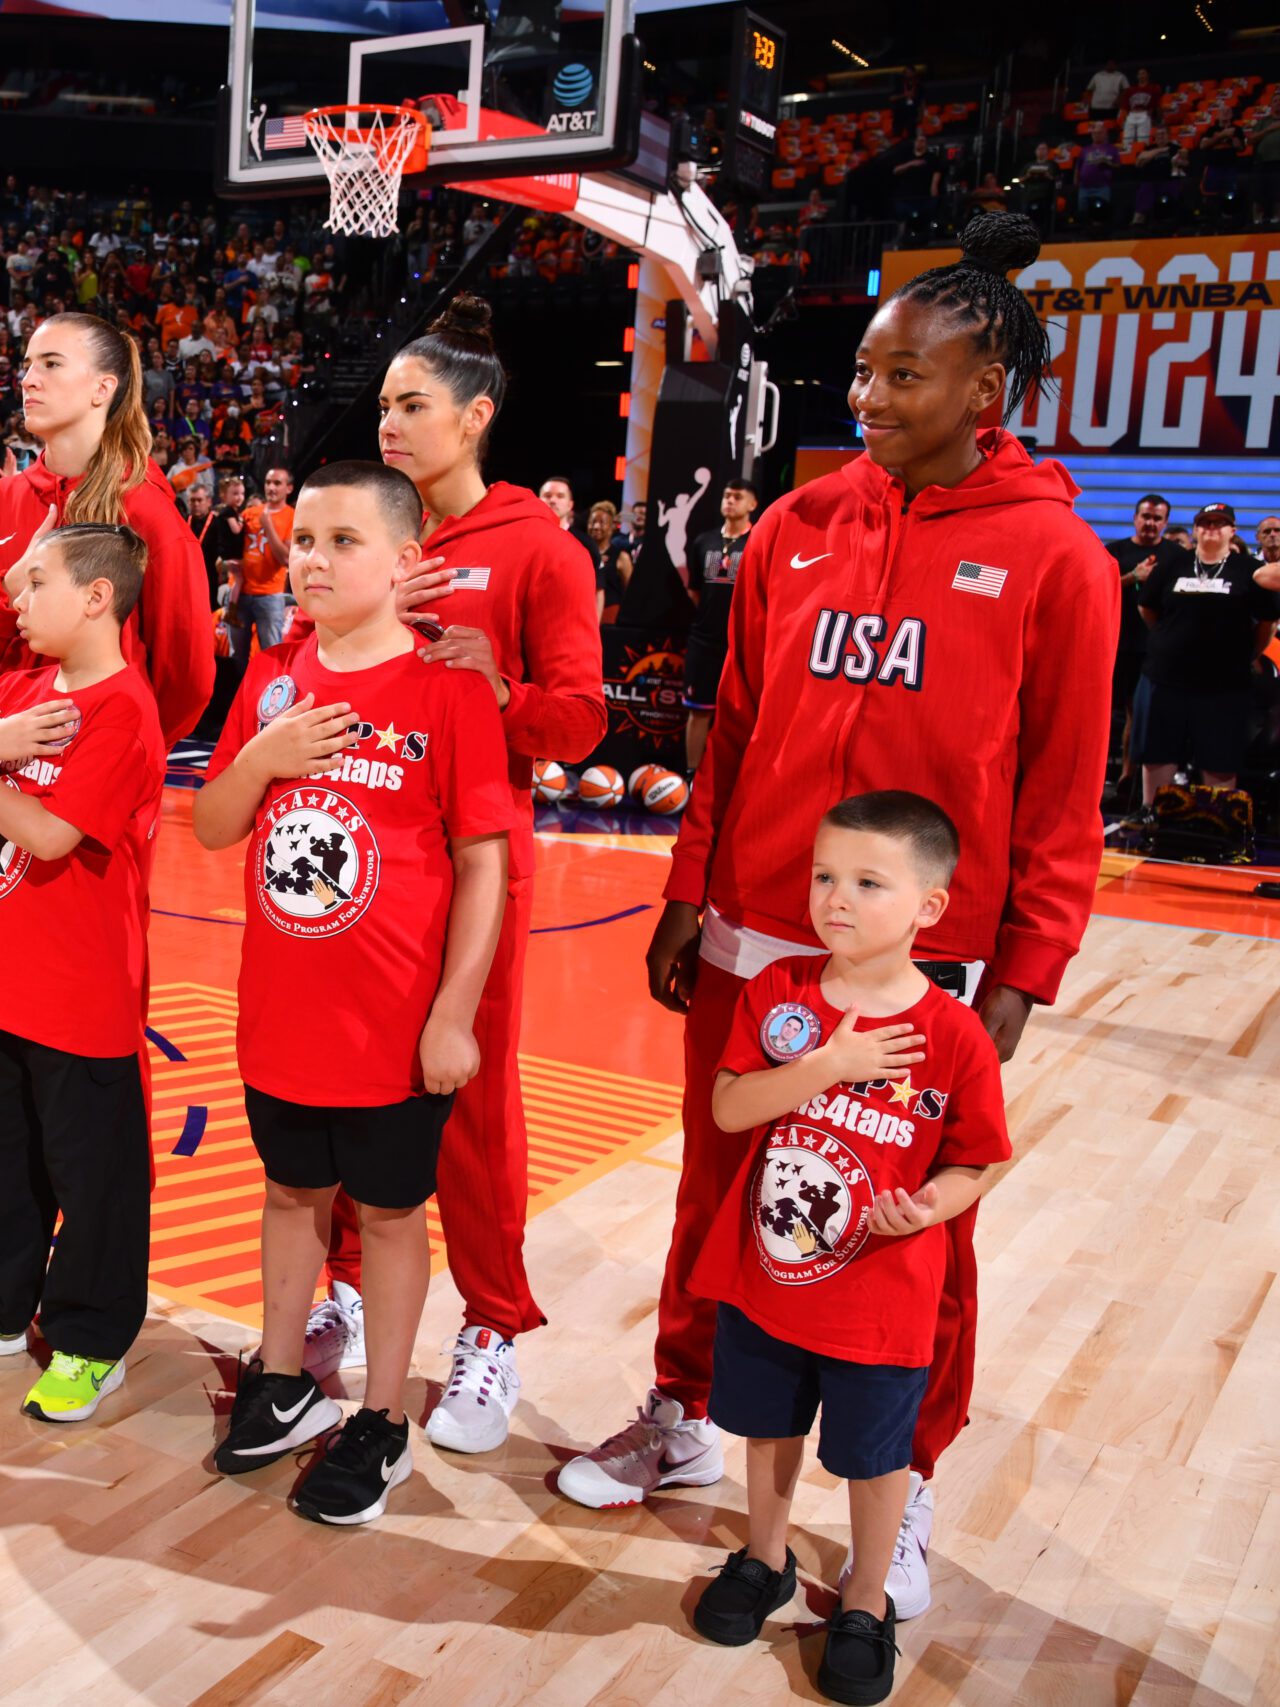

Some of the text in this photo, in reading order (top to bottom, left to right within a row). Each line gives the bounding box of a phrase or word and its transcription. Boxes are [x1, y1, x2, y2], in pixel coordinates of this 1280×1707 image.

[546, 110, 597, 133] AT&T
[1027, 282, 1274, 312] T&T WNBA
[809, 608, 927, 692] USA
[602, 683, 647, 702] ALL
[5, 849, 29, 884] SURVIVO
[293, 919, 340, 934] PROGRAM
[338, 905, 359, 922] FOR
[354, 849, 375, 906] SURVIVORS
[791, 1092, 915, 1148] s4taps
[786, 1126, 866, 1186] APS
[769, 1205, 870, 1281] OGRAM FOR SURVIVORS
